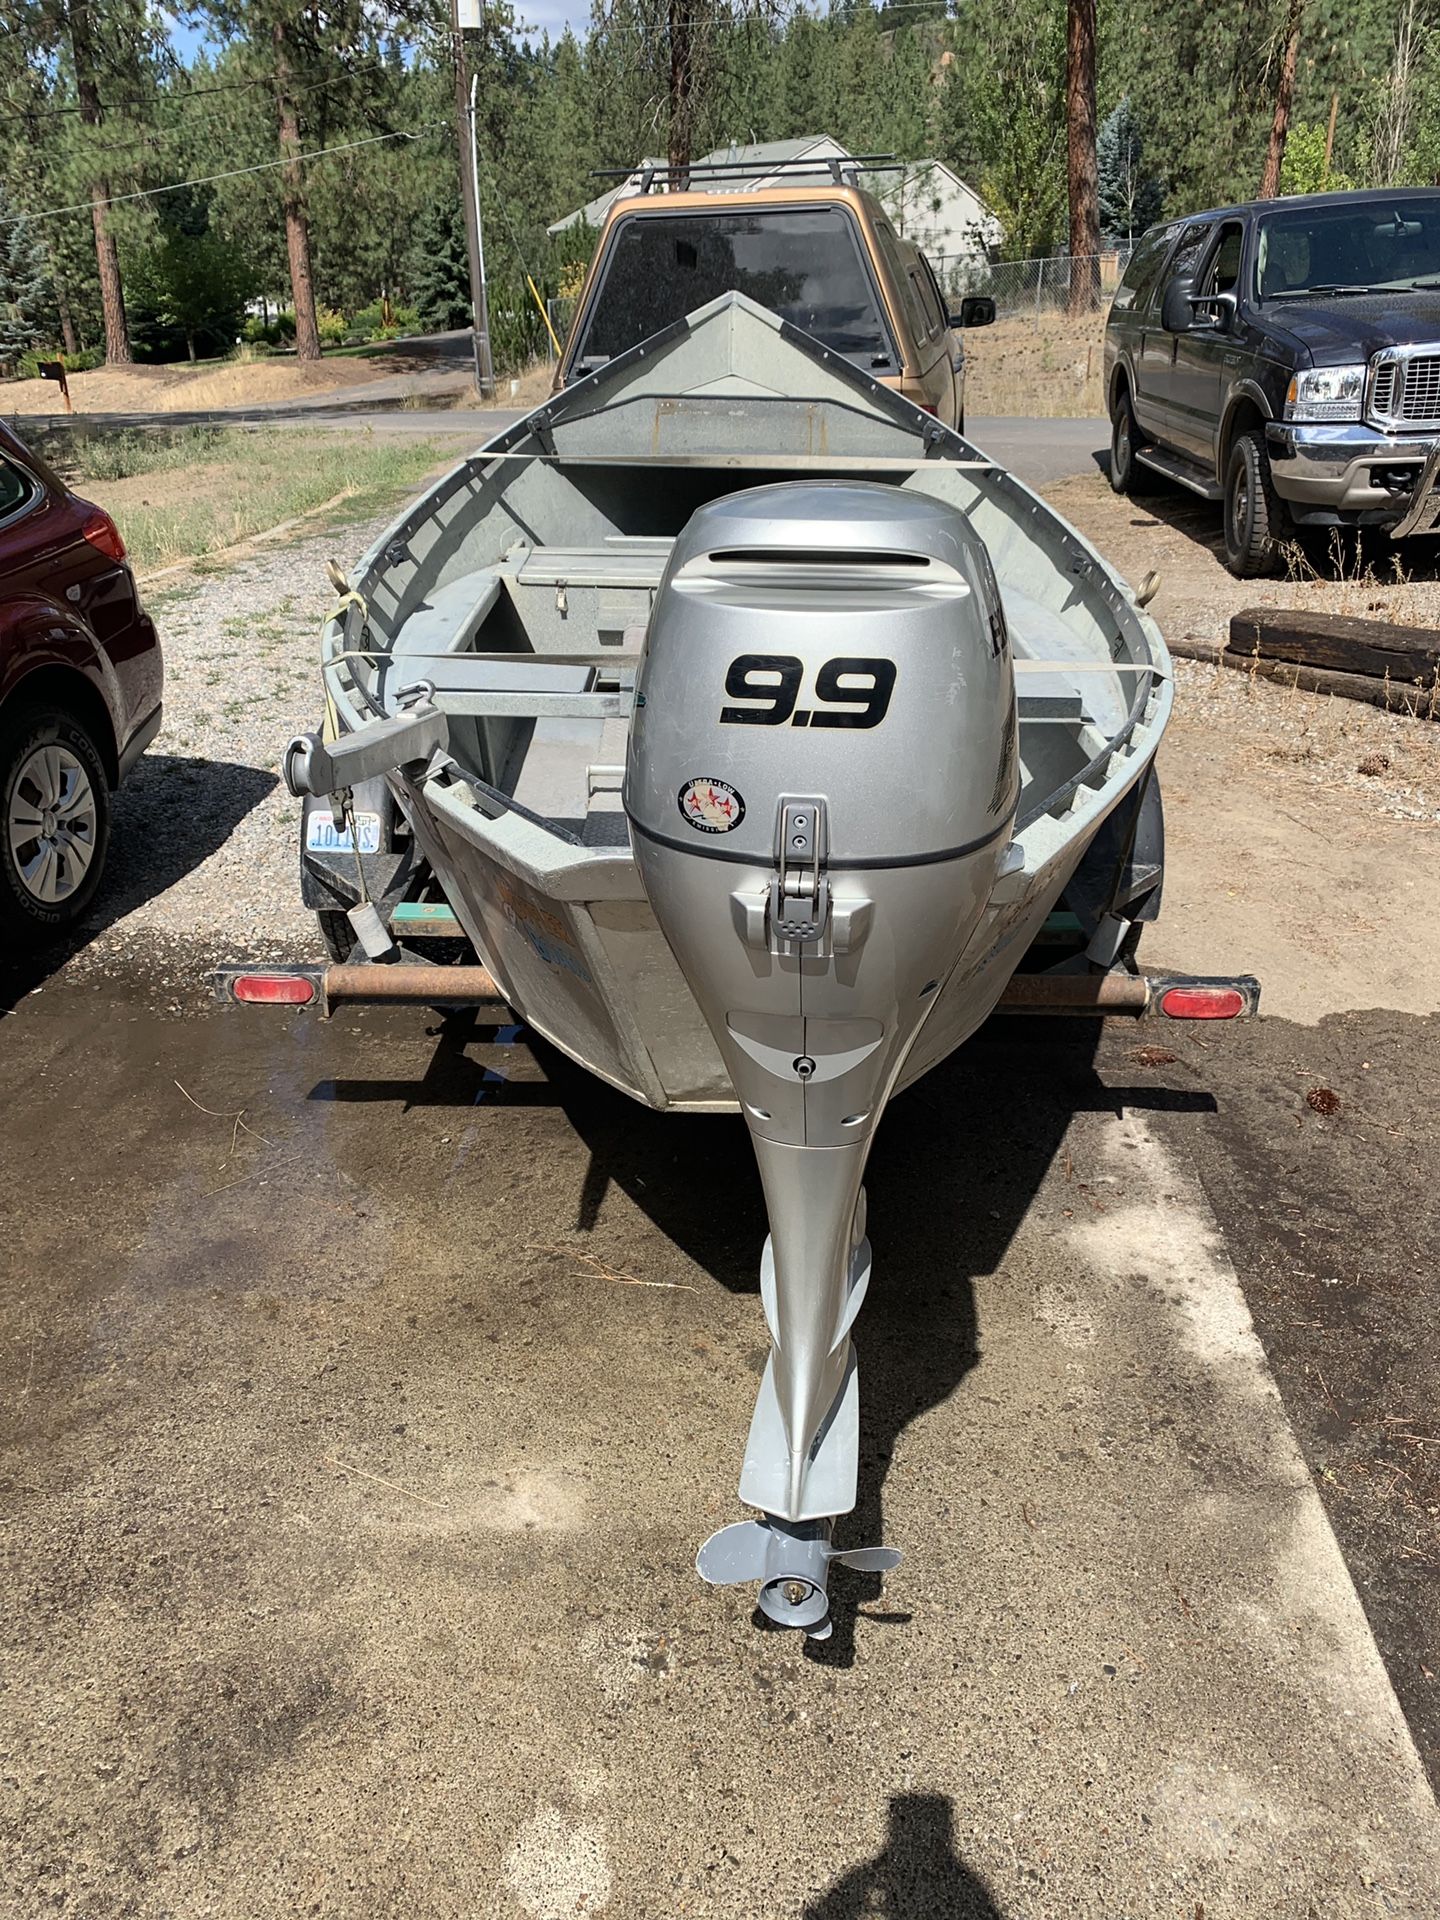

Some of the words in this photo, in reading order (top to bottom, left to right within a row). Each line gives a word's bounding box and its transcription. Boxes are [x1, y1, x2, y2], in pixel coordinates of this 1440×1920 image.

[719, 654, 897, 729] 9.9
[718, 781, 735, 794] LOW
[692, 821, 726, 832] EMISSI
